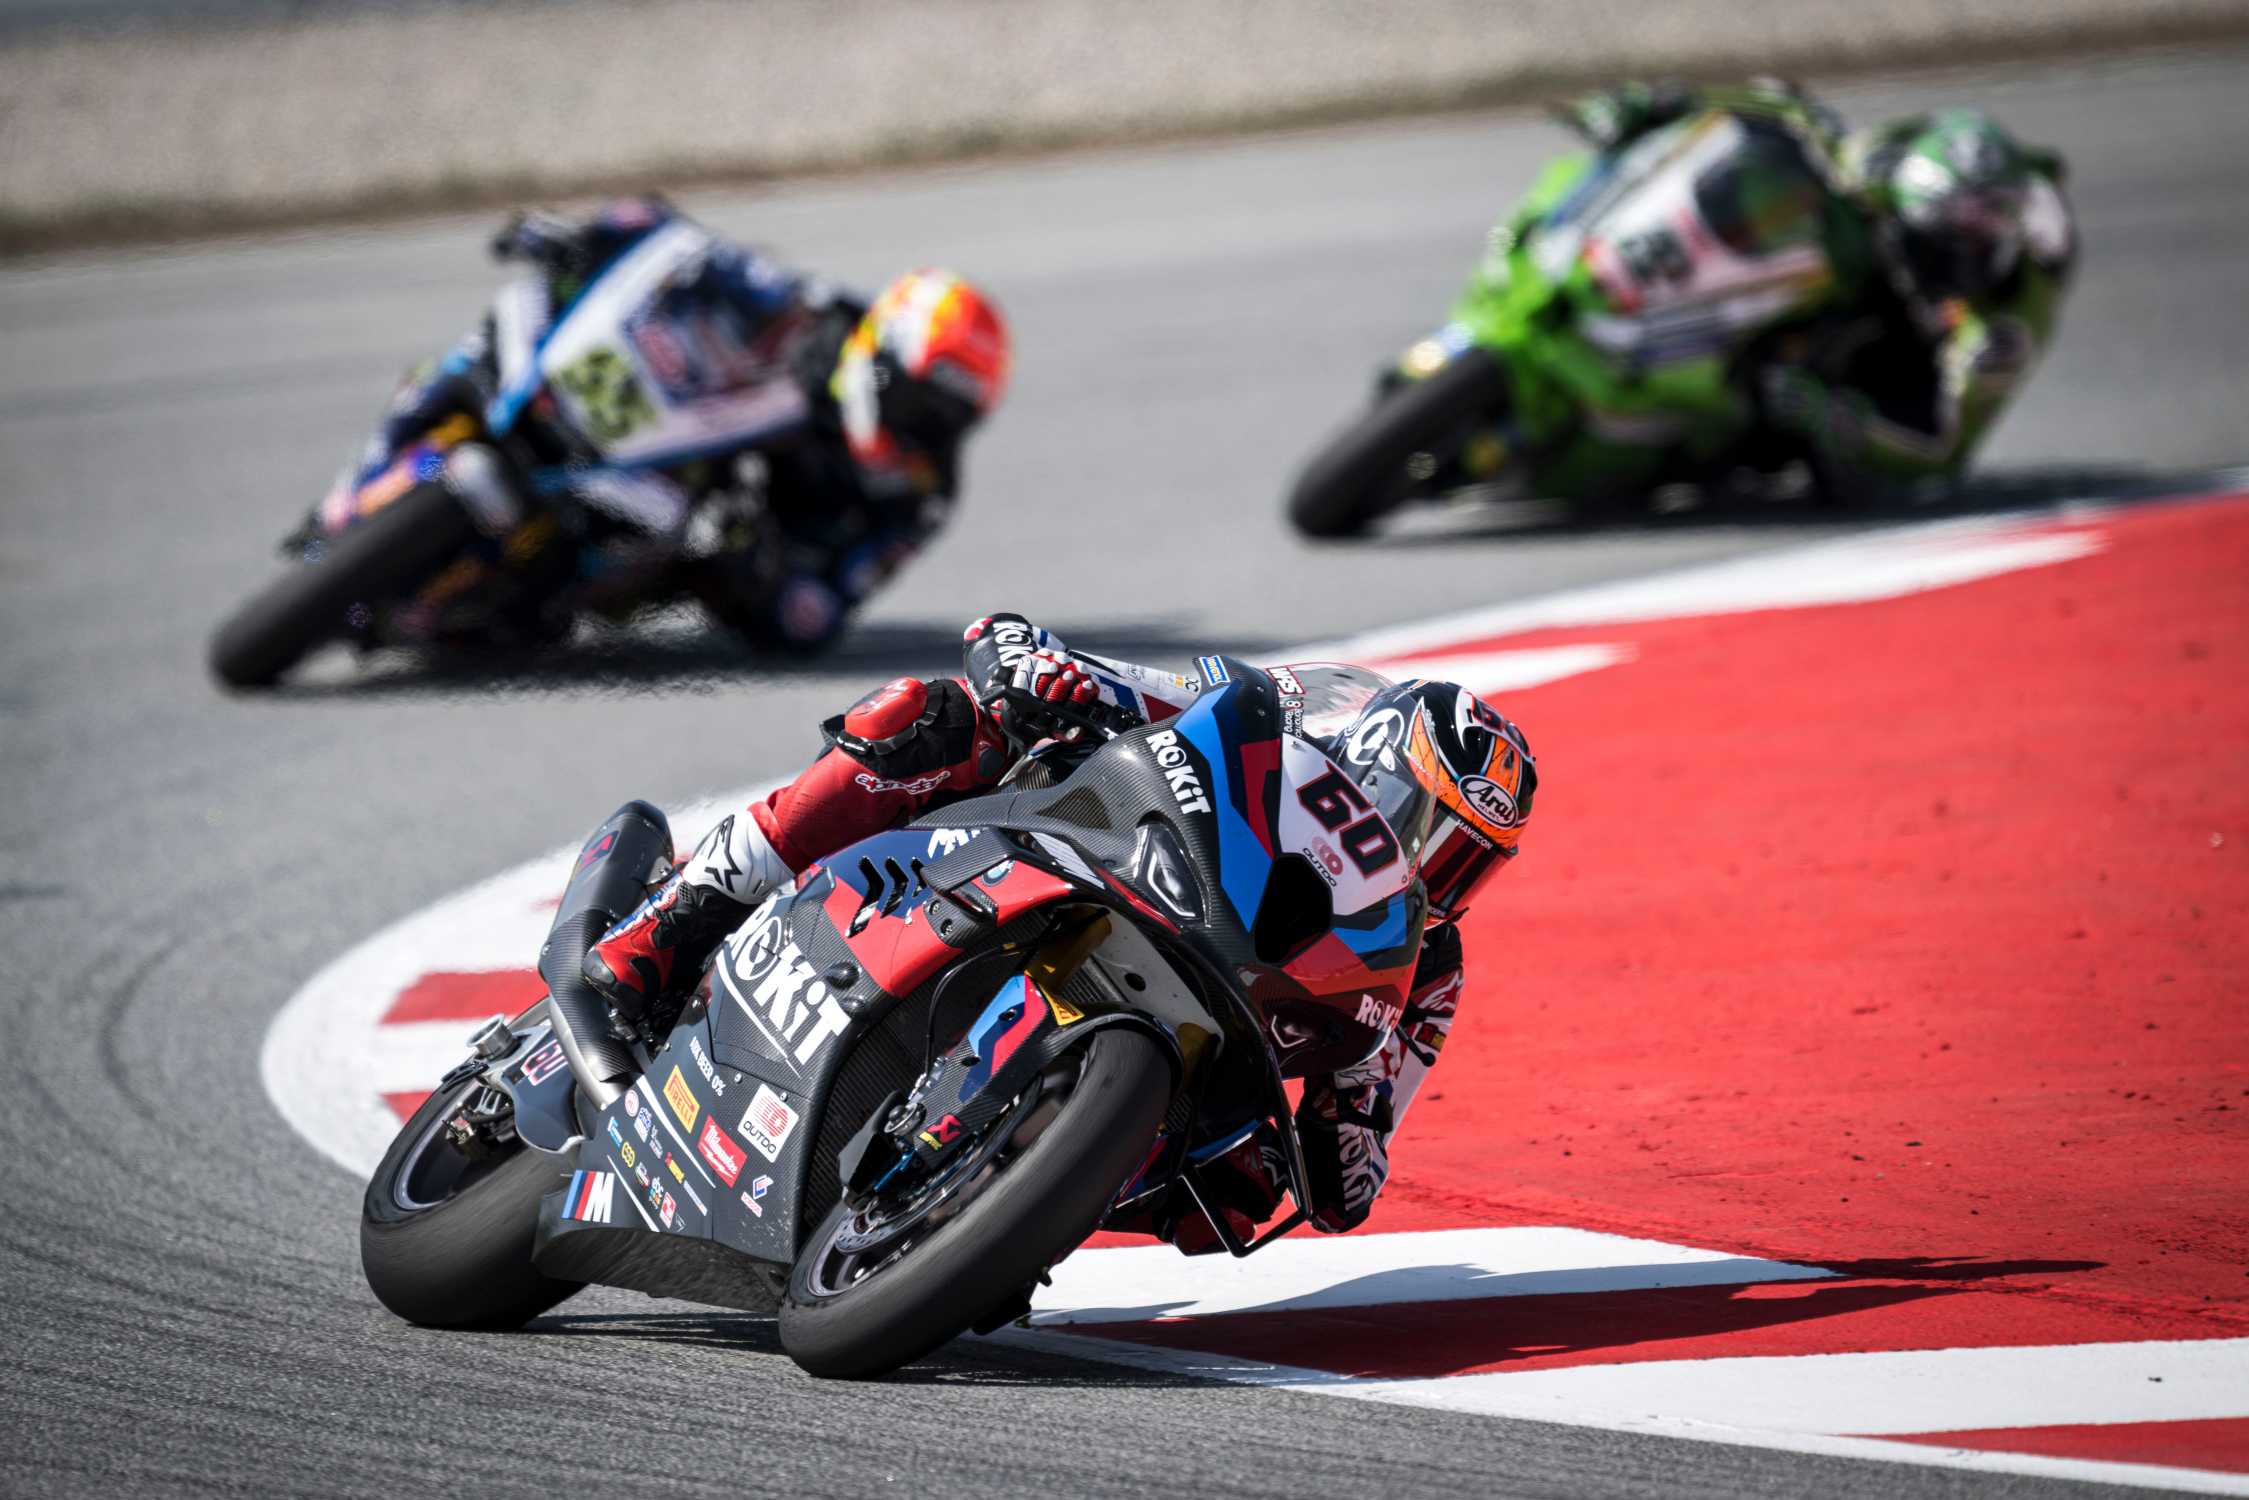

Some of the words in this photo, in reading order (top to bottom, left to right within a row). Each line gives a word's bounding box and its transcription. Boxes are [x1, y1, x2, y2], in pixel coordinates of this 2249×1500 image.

[1296, 759, 1399, 880] 60
[1465, 785, 1513, 822] Arai
[697, 1050, 714, 1082] BEER
[704, 1125, 738, 1174] Milwaukee
